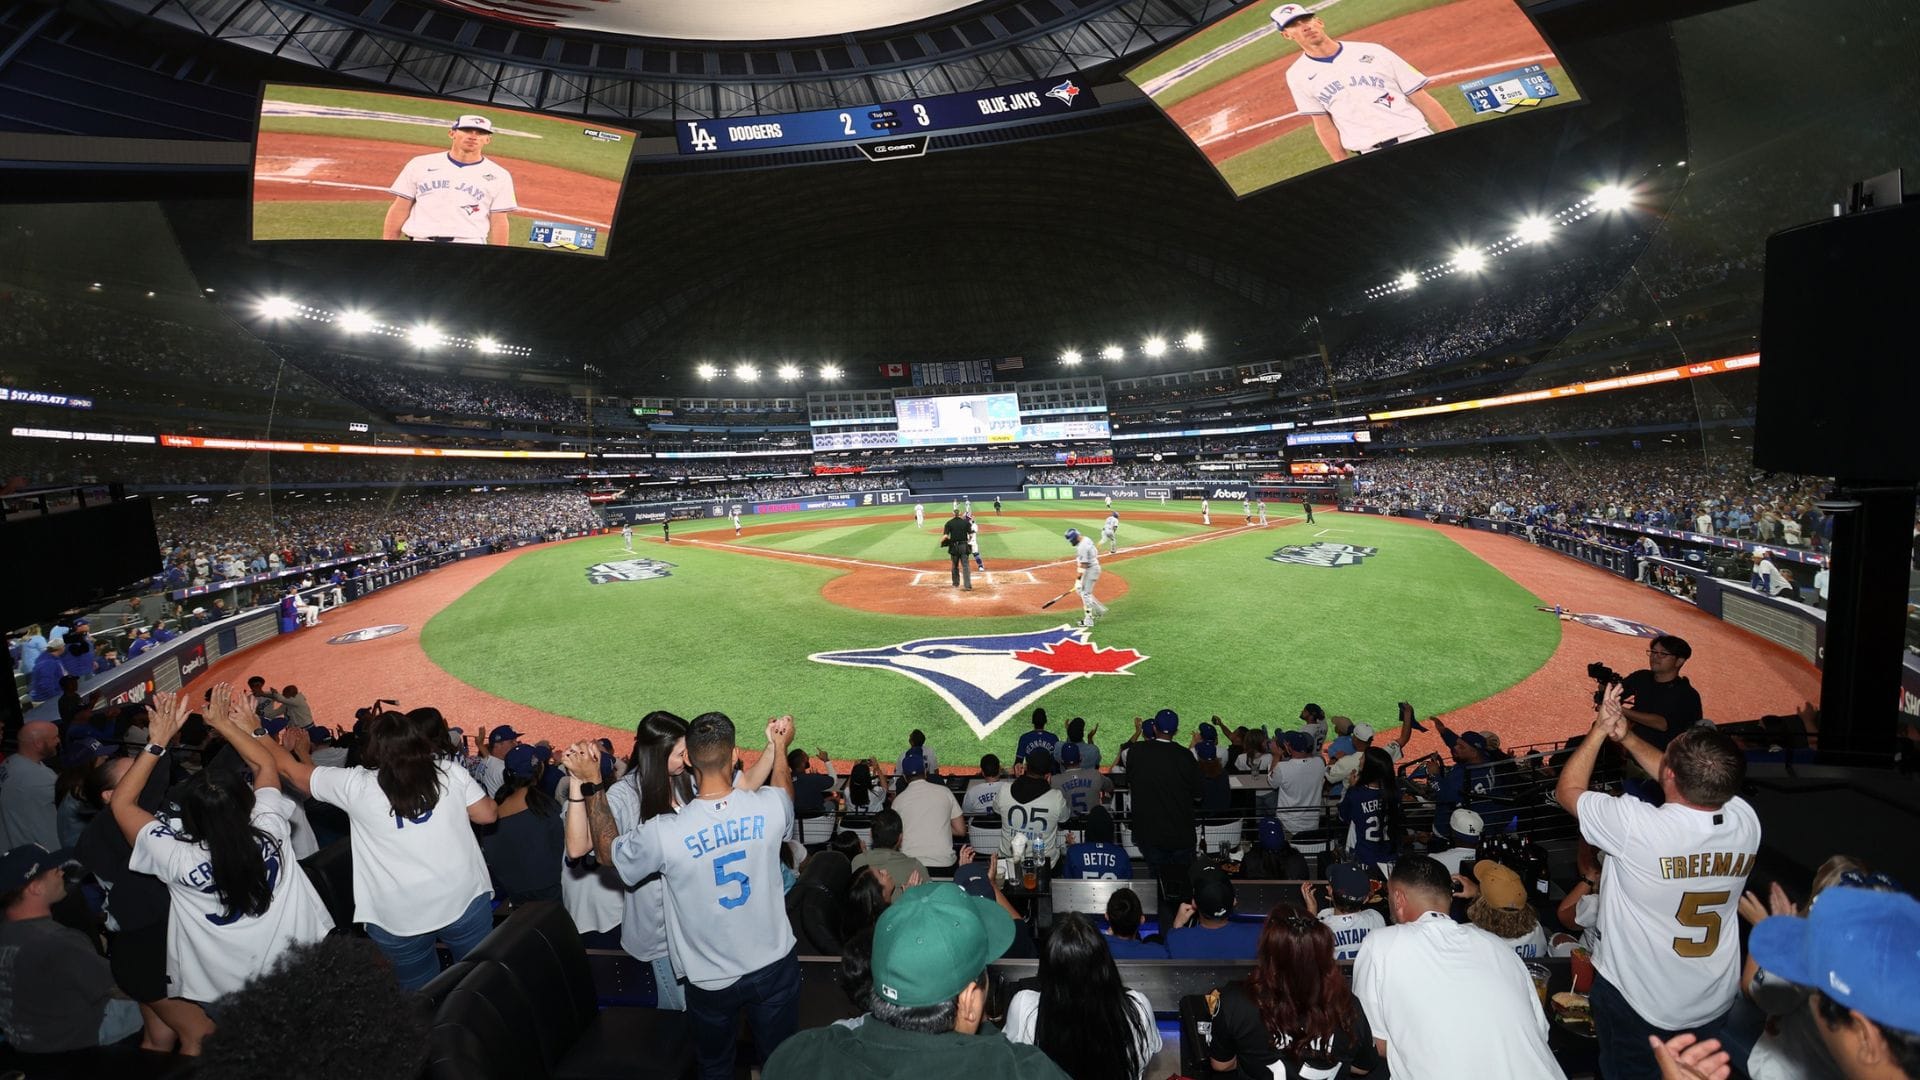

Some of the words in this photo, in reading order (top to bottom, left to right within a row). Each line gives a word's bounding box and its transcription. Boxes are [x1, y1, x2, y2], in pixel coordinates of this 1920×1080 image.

[1349, 75, 1385, 88] JAYS
[1525, 75, 1544, 84] TOR
[1470, 89, 1488, 99] LAD
[1535, 85, 1546, 95] 3
[977, 97, 1010, 115] BLUE
[1010, 91, 1041, 111] JAYS
[1480, 99, 1491, 109] 2
[913, 104, 930, 126] 3
[839, 113, 856, 135] 2
[688, 122, 717, 151] LA
[728, 123, 783, 142] DODGERS
[581, 239, 589, 247] 3
[1076, 456, 1112, 464] ROGERS
[881, 492, 904, 503] BET
[1213, 488, 1248, 500] Sobeys
[128, 682, 147, 704] SHOP
[1062, 779, 1092, 792] FREEMAN
[1071, 792, 1088, 817] 5
[1361, 800, 1382, 814] KER
[684, 815, 765, 858] SEAGER
[1083, 852, 1116, 867] BETTS
[713, 850, 751, 910] 5
[1672, 890, 1731, 958] 5
